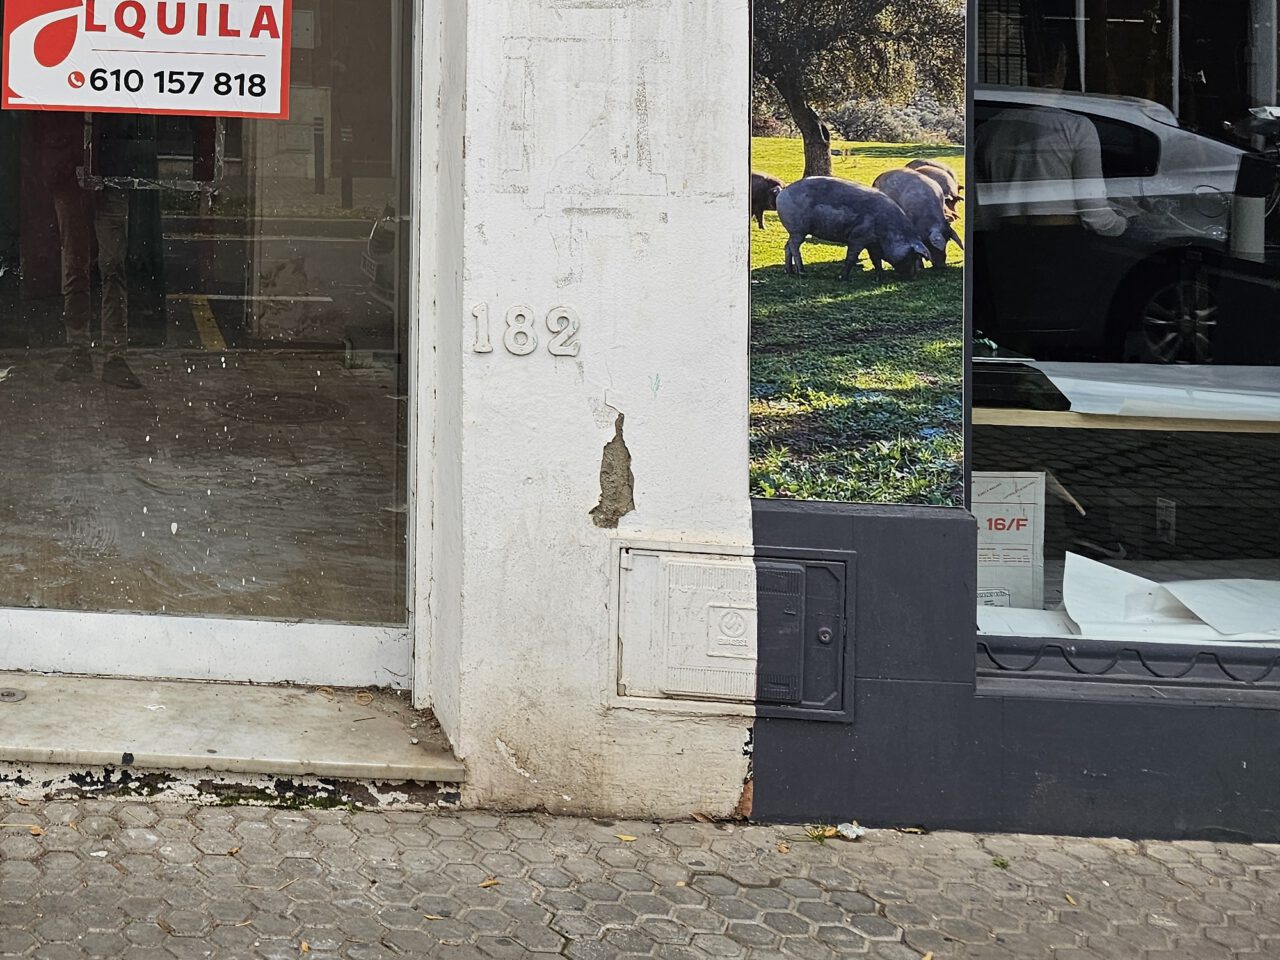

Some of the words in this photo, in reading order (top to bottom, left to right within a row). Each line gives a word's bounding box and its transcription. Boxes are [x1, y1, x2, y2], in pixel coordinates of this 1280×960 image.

[90, 68, 144, 93] 610
[153, 70, 205, 95] 157
[213, 72, 267, 98] 818
[472, 302, 581, 357] 182
[987, 518, 1029, 531] 16/F
